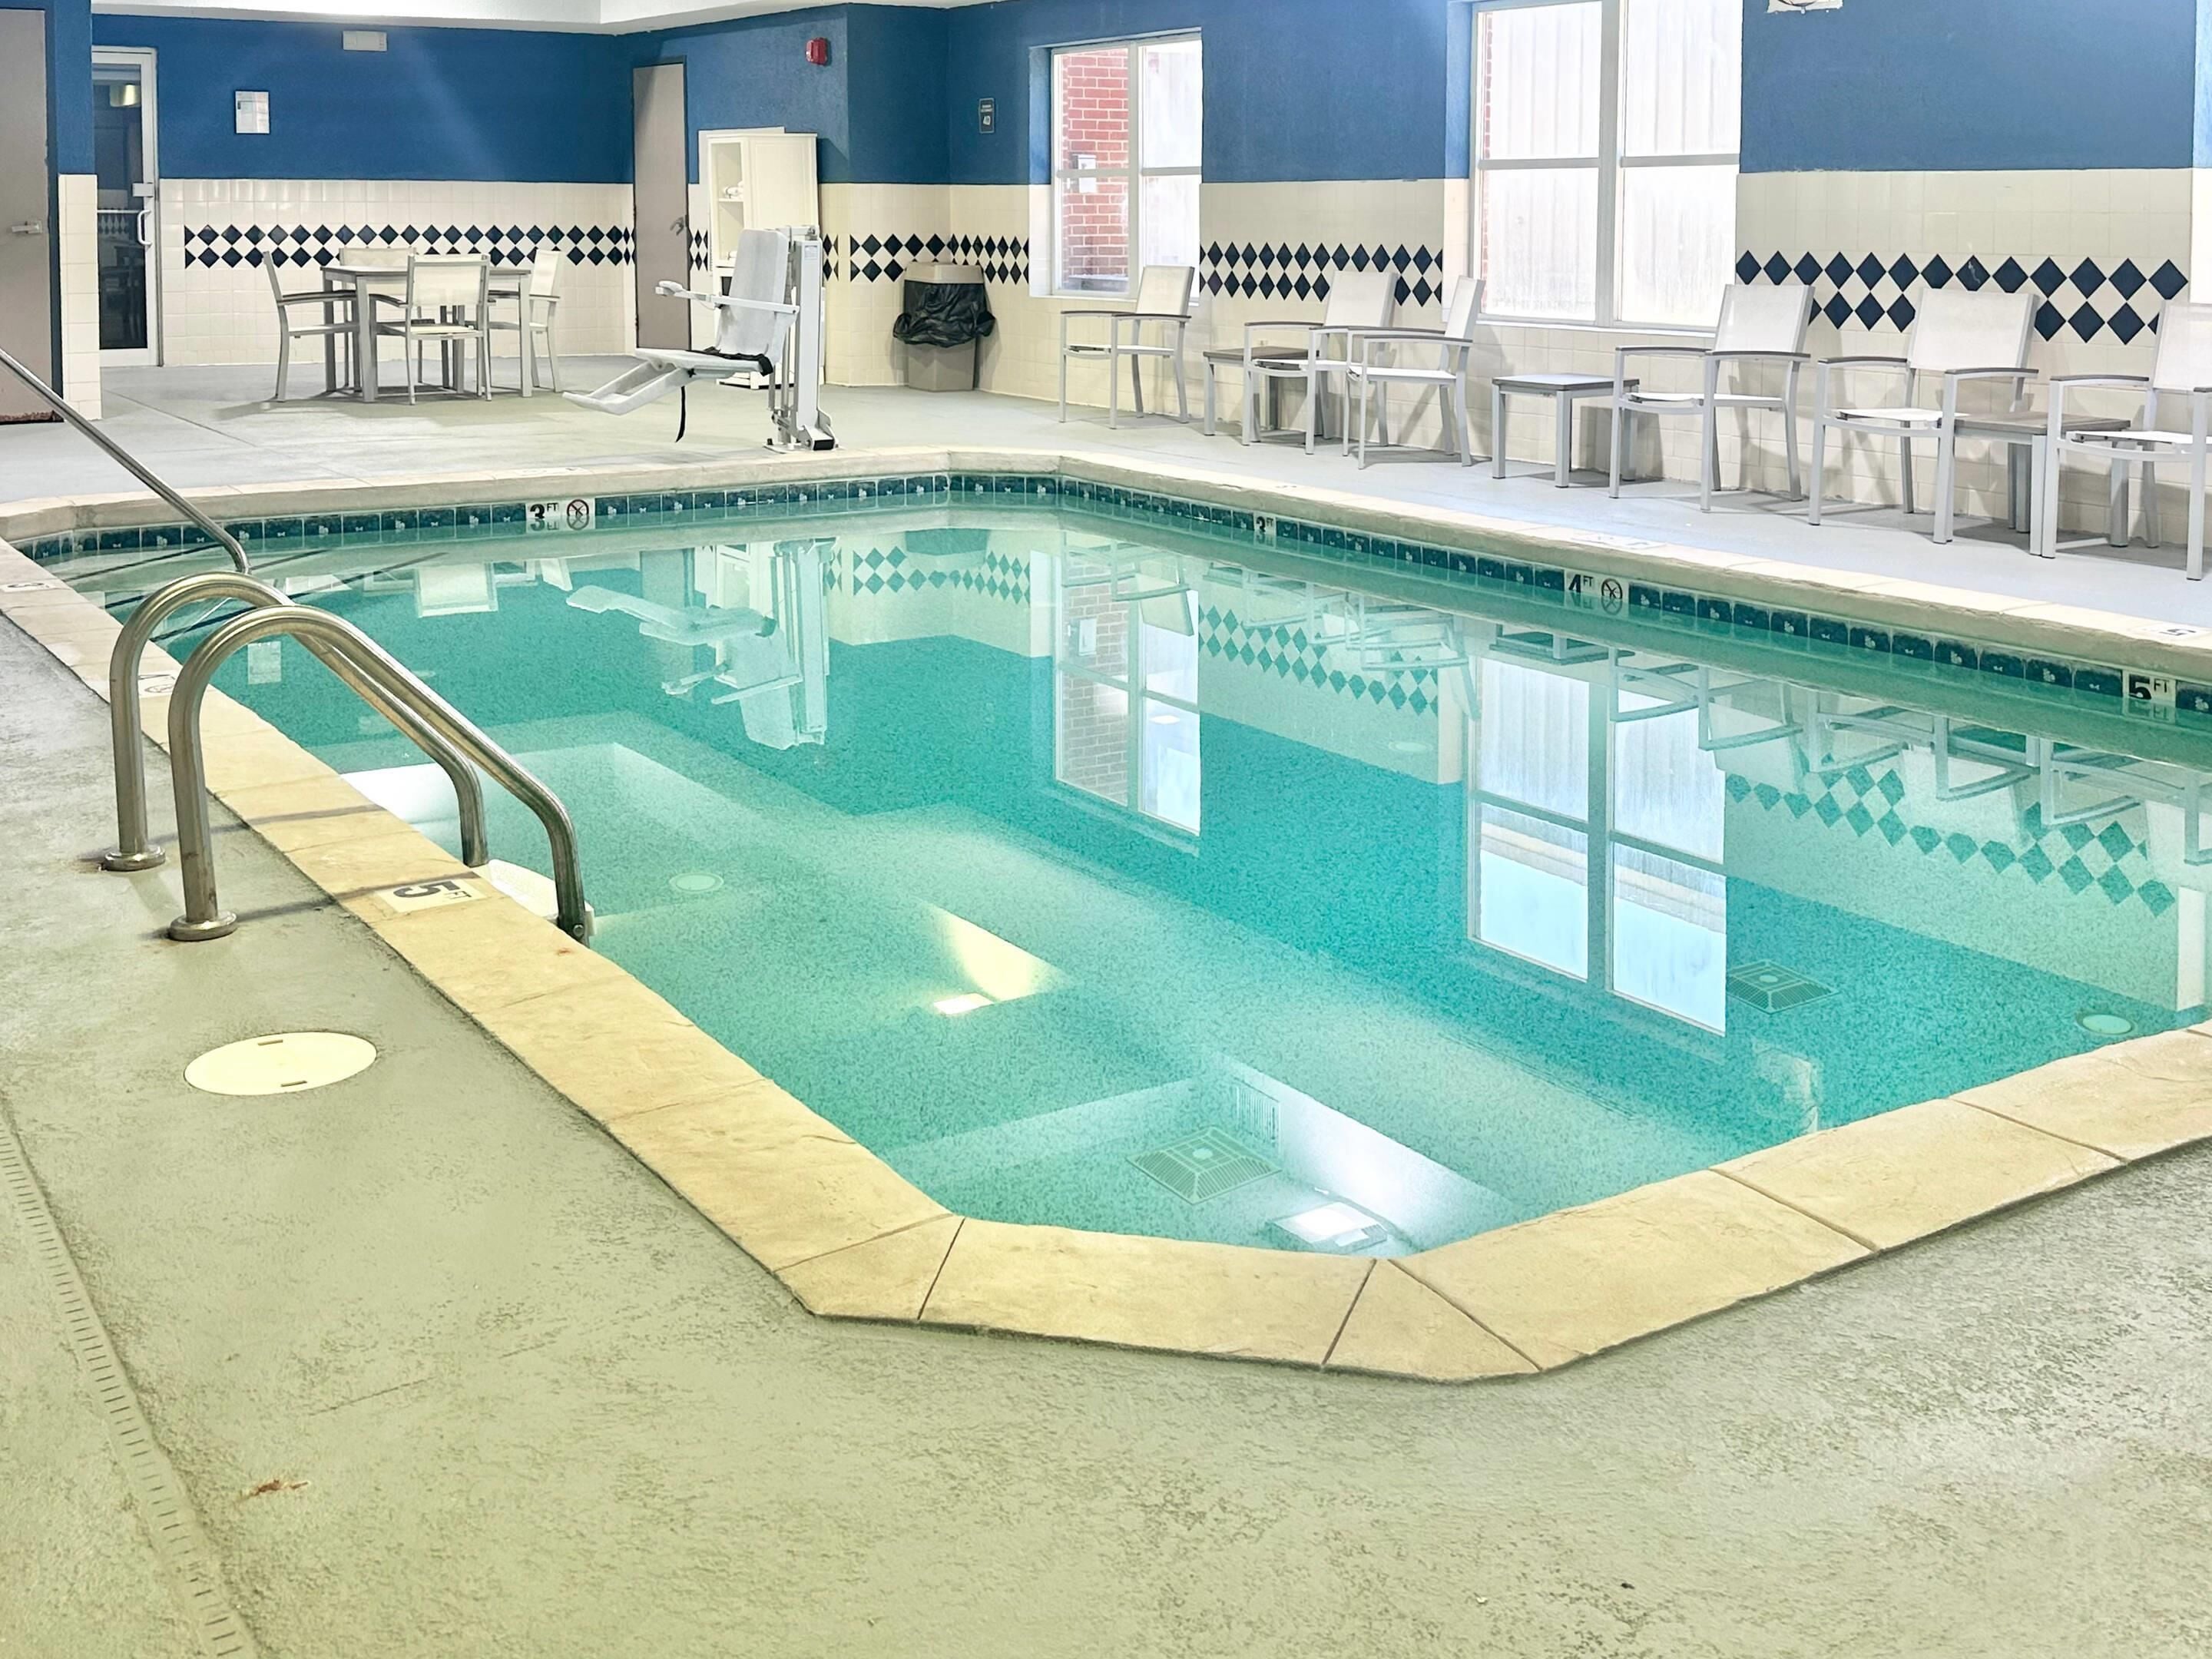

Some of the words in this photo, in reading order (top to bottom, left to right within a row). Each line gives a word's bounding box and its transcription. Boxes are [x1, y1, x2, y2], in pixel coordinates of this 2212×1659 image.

[547, 502, 558, 512] FT
[1583, 575, 1594, 587] FT
[2128, 674, 2152, 700] 5
[2154, 678, 2169, 693] FT
[393, 880, 460, 898] 5
